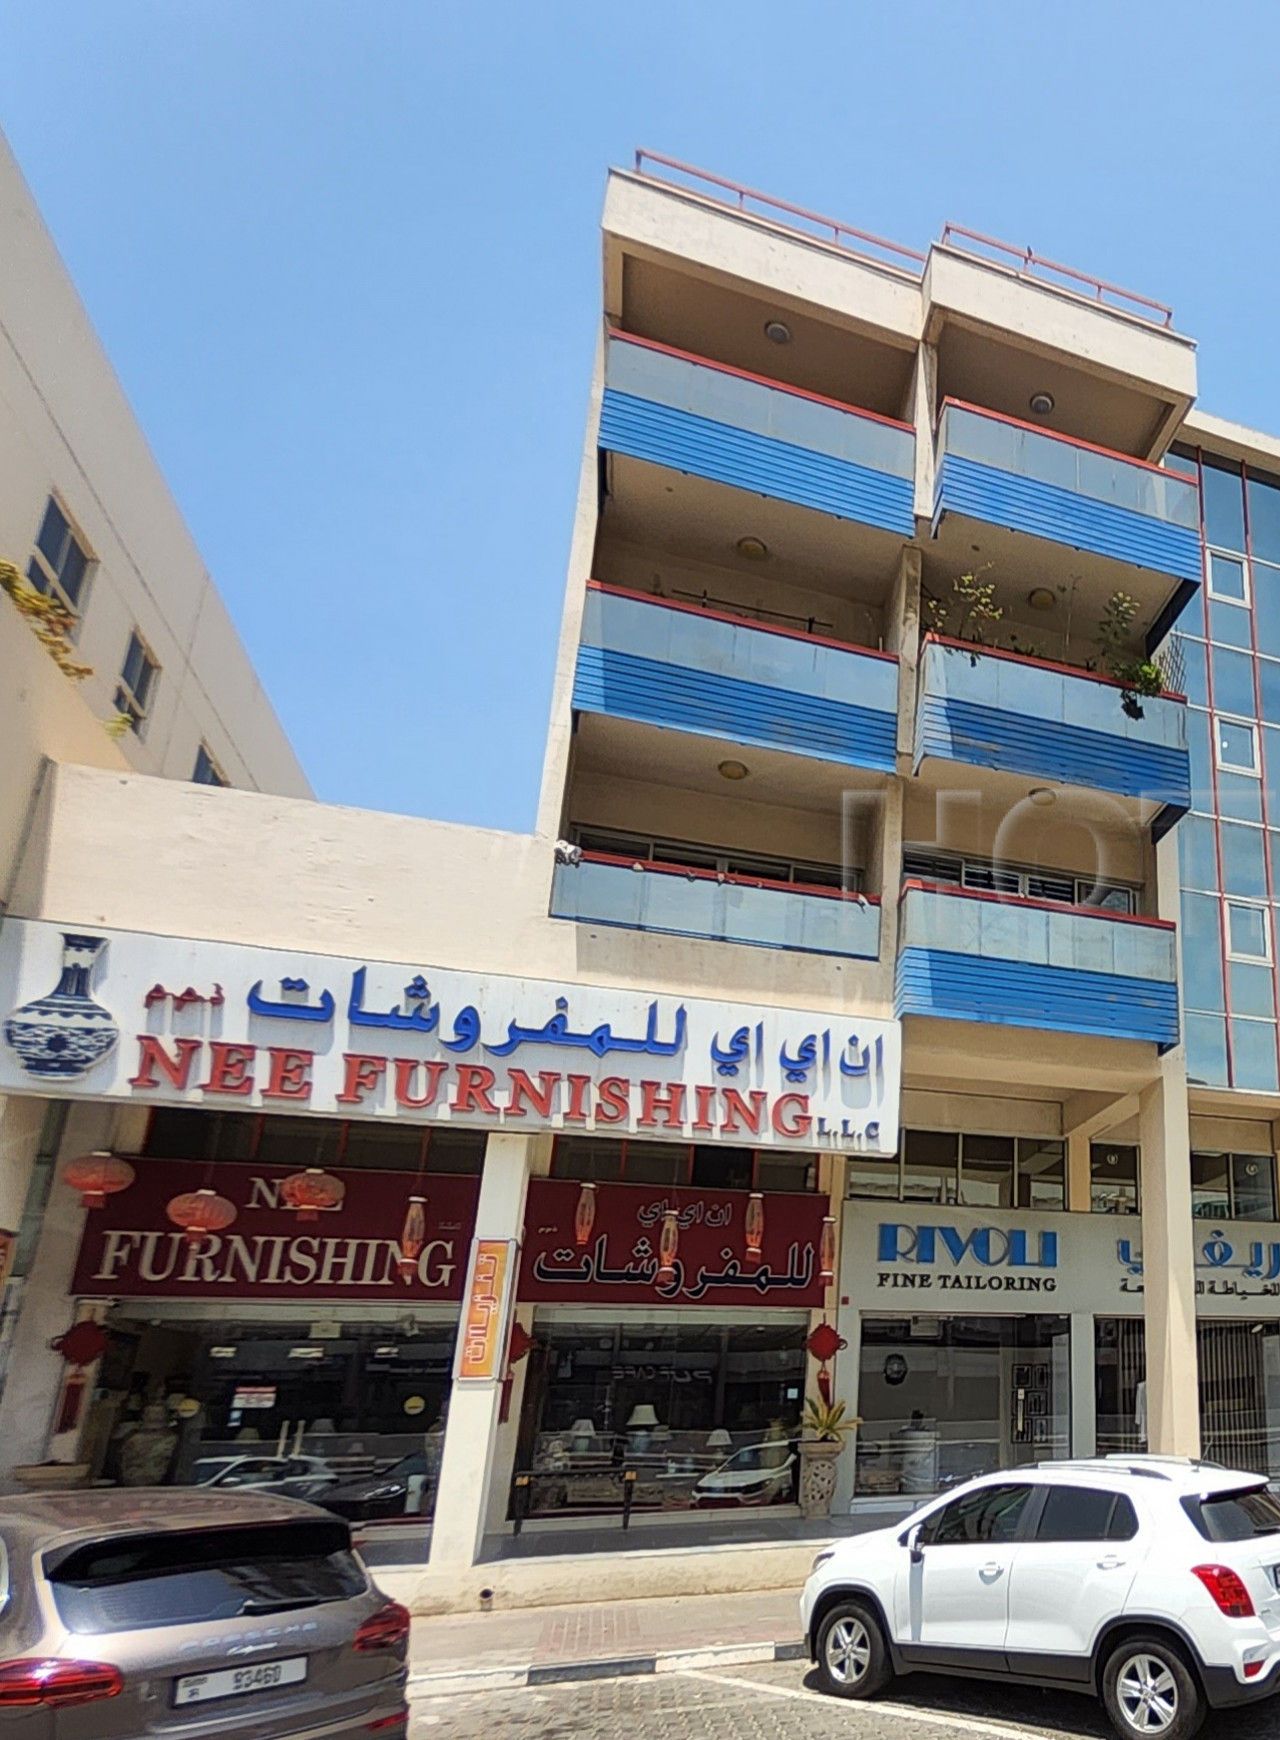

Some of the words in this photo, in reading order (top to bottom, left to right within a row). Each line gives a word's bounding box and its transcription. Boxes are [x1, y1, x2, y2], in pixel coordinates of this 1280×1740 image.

[247, 965, 688, 1058] للمفروشات
[710, 1021, 765, 1077] اي
[779, 1028, 831, 1083] اي
[839, 1033, 884, 1078] ان
[128, 1034, 316, 1101] NEE
[335, 1053, 813, 1140] FURNISHING
[877, 1222, 1059, 1269] RIVOLI
[466, 1253, 498, 1365] تنزيلات
[877, 1272, 933, 1290] FINE
[937, 1274, 1058, 1293] TAILORING
